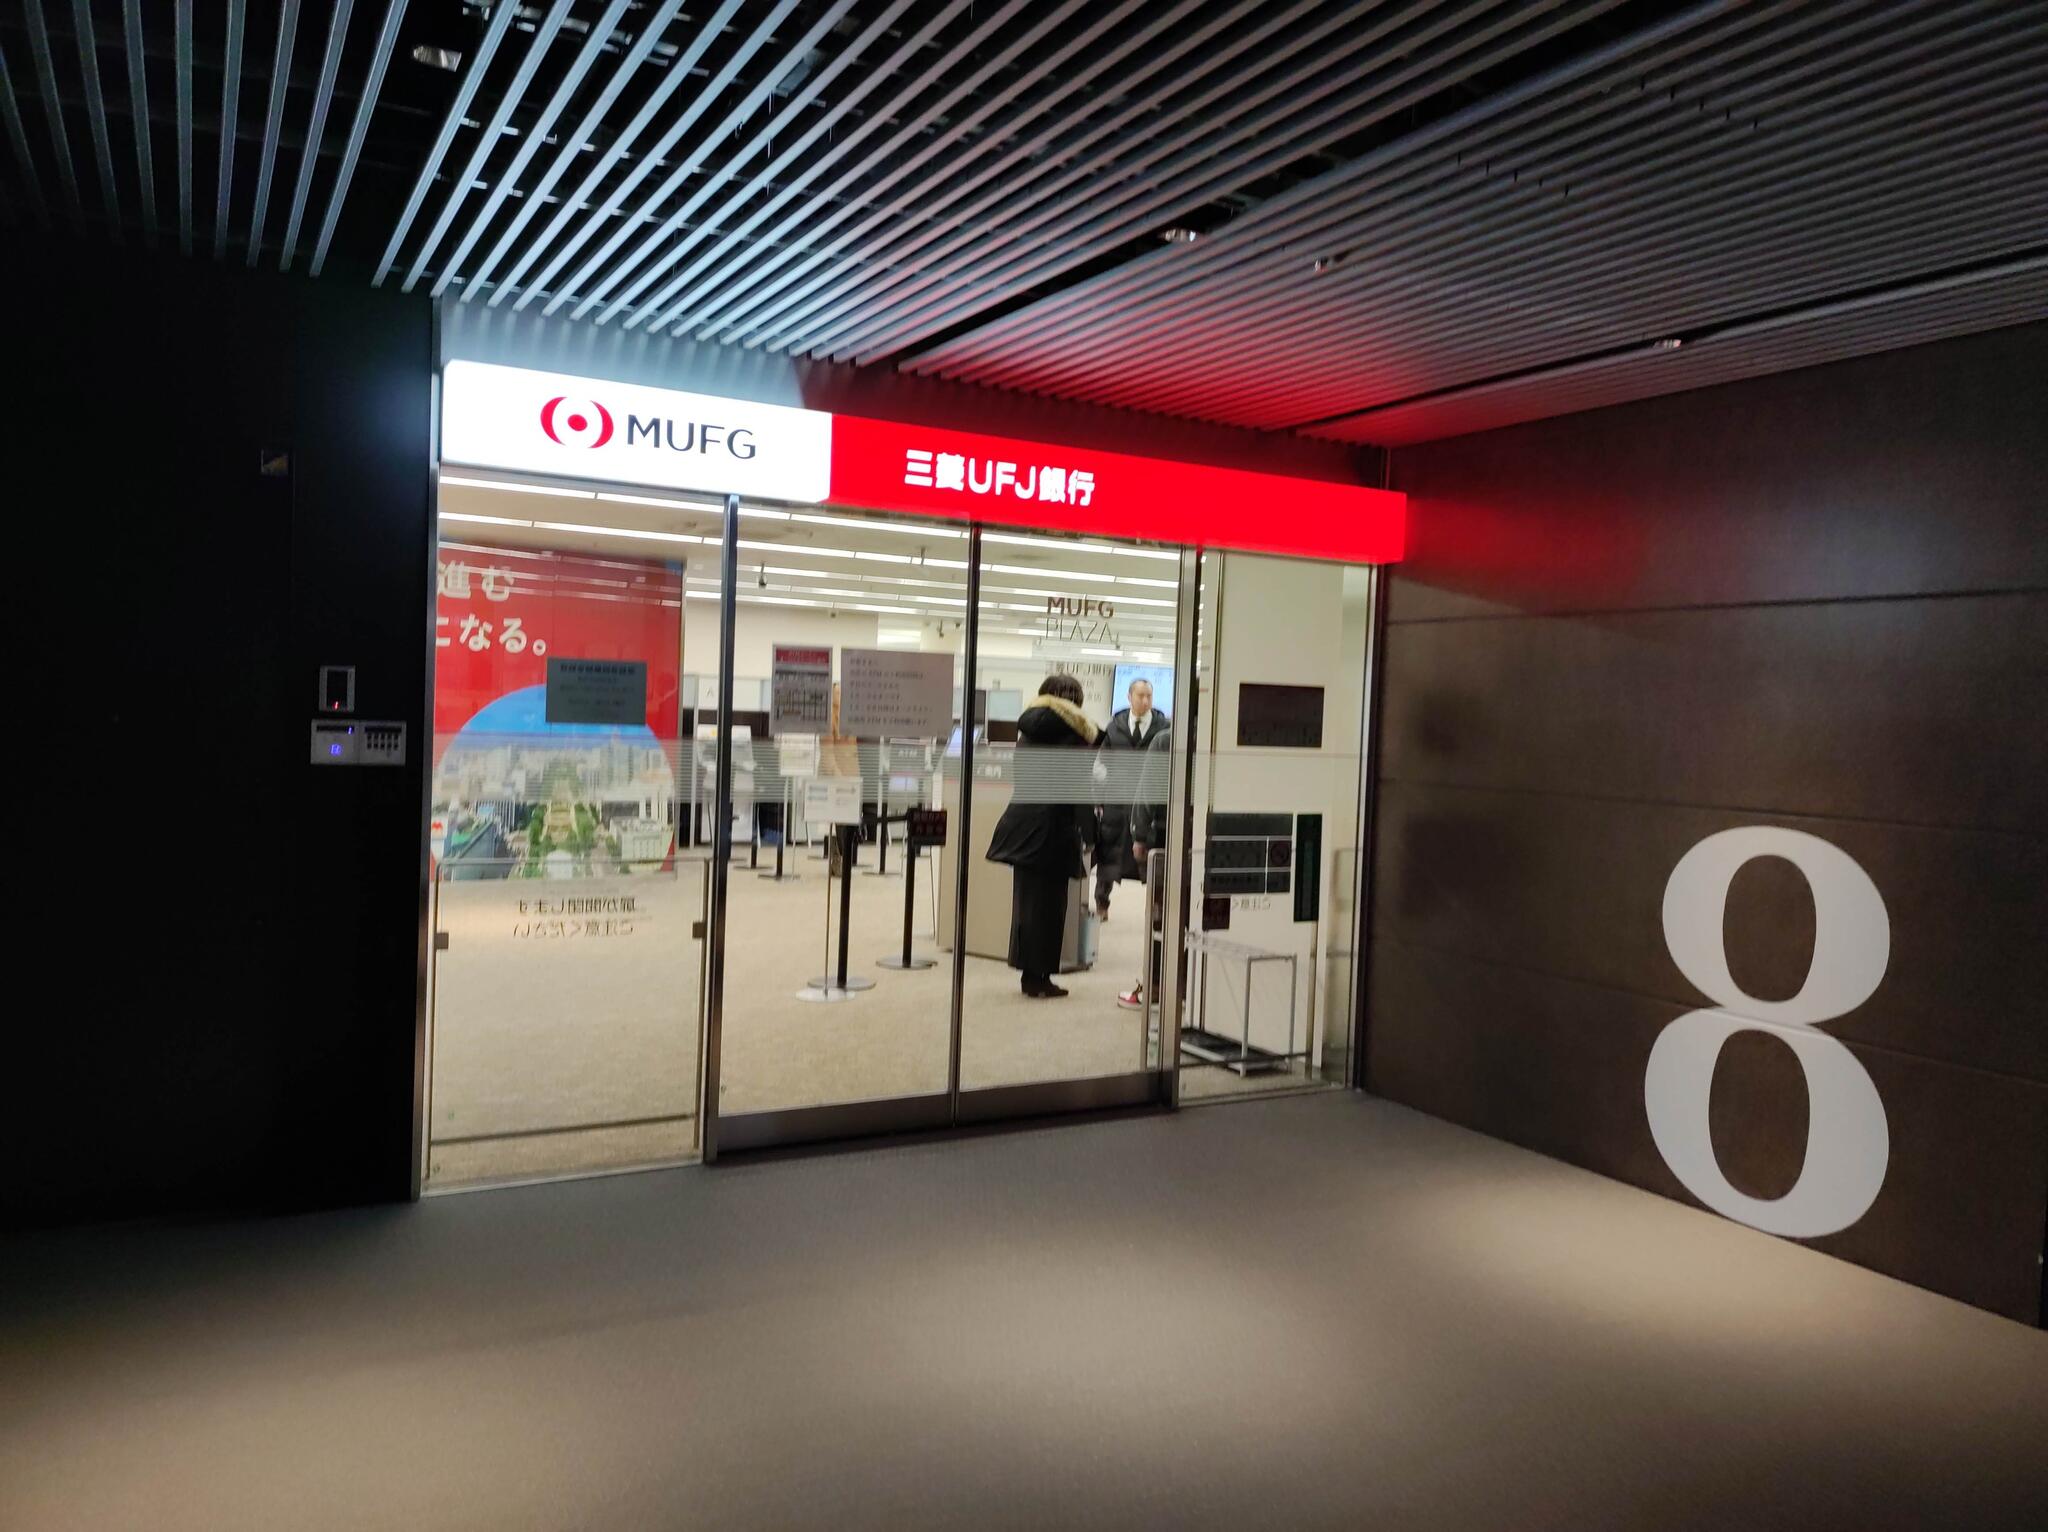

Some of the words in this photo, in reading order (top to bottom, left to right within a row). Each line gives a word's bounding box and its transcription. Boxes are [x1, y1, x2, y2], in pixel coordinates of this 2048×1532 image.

[627, 414, 757, 460] MUFG
[904, 448, 1096, 508] 三菱UFJ銀行
[1044, 616, 1113, 644] PLAZA
[1046, 596, 1115, 619] MUFG
[1645, 827, 1891, 1239] 8
